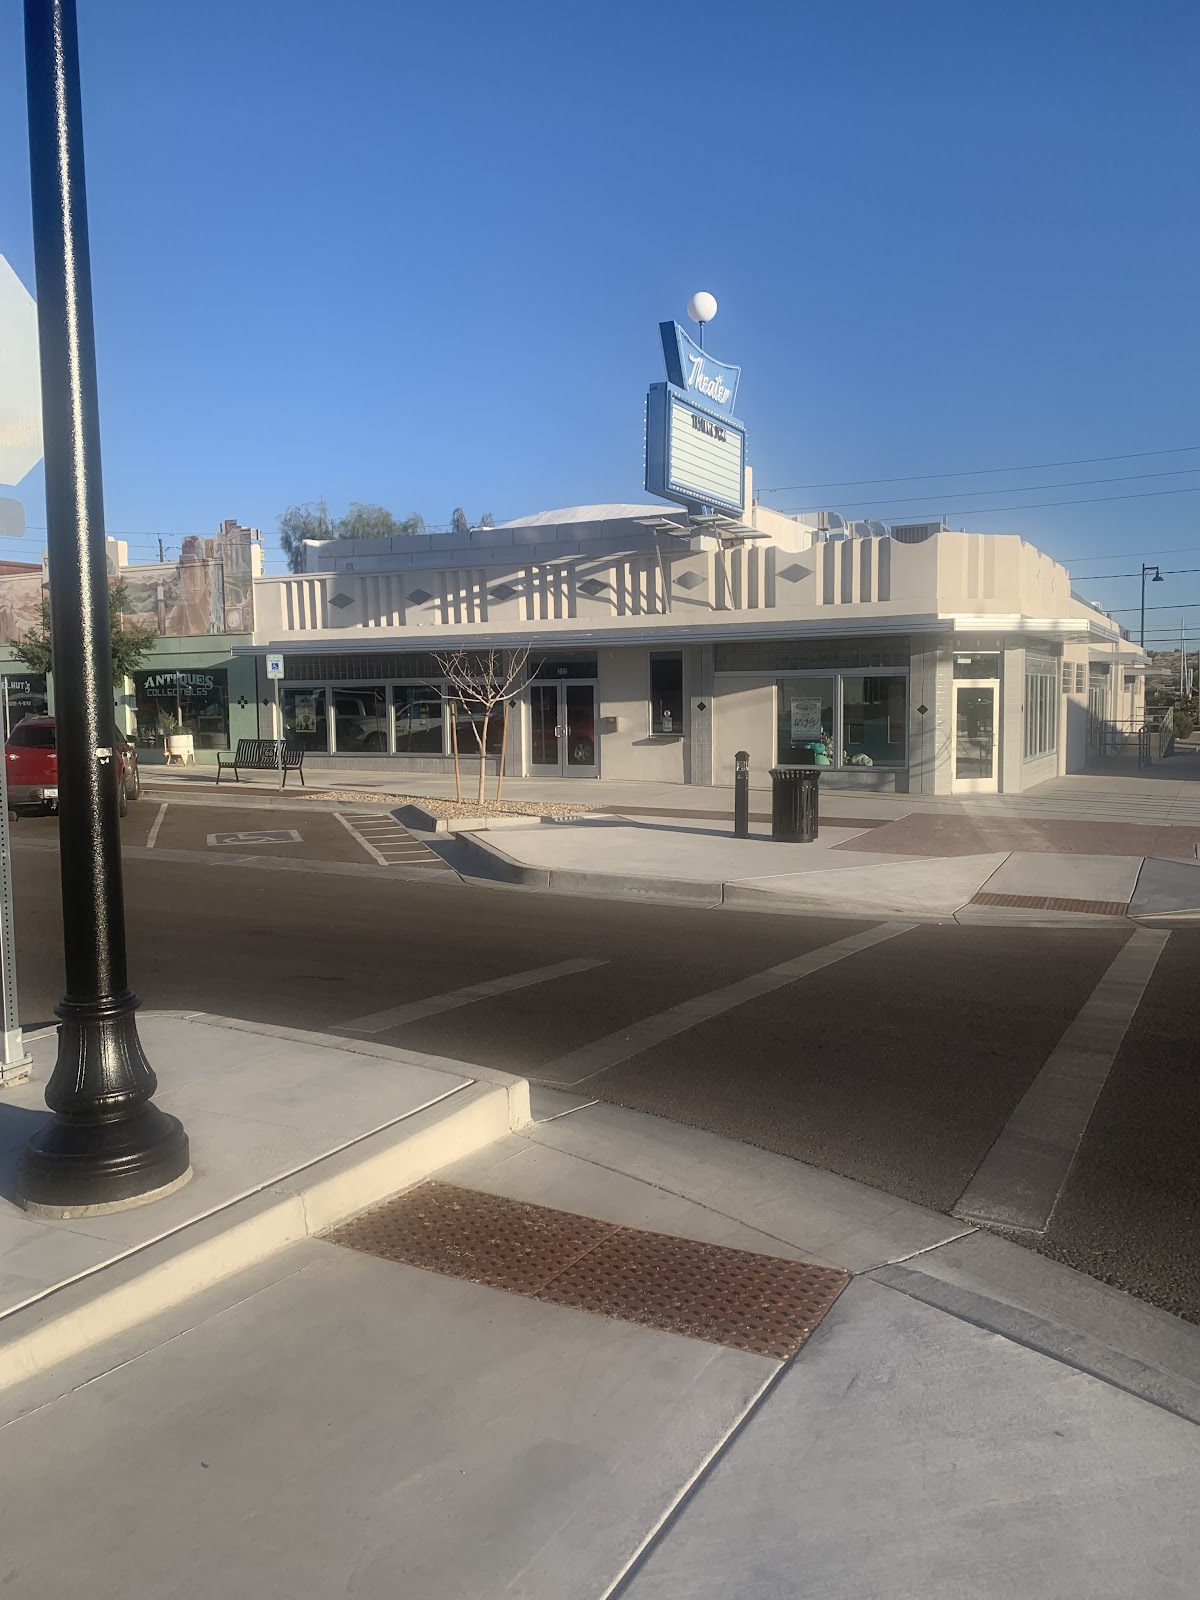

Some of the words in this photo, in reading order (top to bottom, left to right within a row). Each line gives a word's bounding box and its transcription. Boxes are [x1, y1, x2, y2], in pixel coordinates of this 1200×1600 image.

[688, 353, 730, 404] Theater
[144, 673, 214, 690] ANTIQUES
[147, 688, 208, 697] COLLECTIBLES
